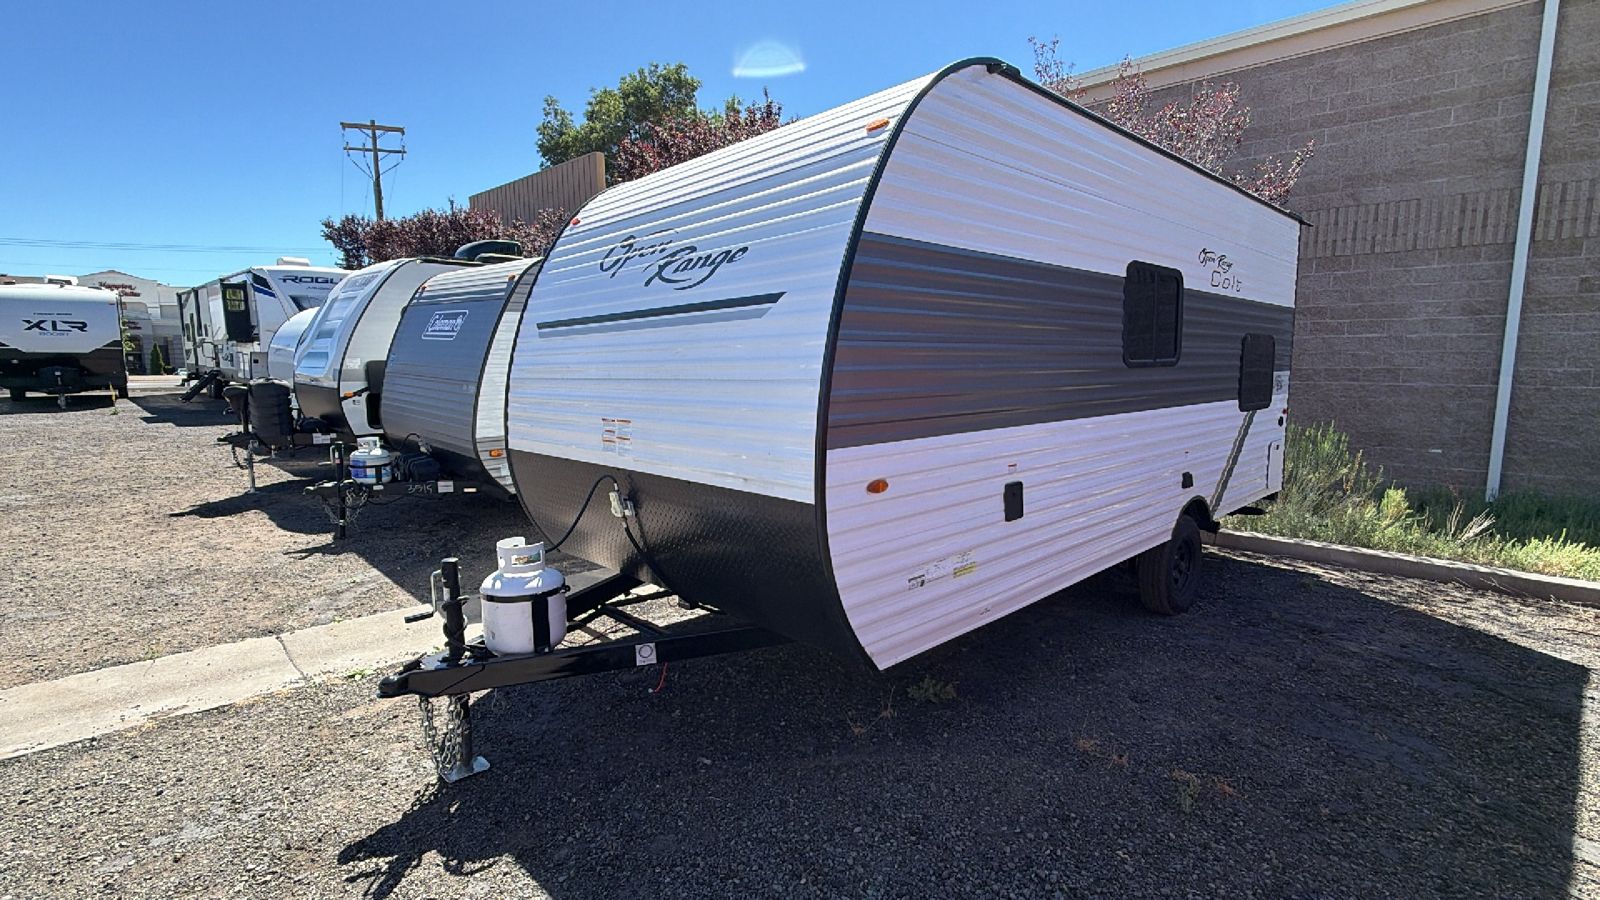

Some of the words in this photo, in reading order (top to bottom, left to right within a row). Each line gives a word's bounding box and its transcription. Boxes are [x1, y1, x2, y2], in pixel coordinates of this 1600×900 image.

[600, 229, 678, 278] Open
[1198, 248, 1216, 267] Open
[643, 246, 749, 290] Range
[1211, 270, 1242, 292] Colt
[21, 319, 88, 332] XLR
